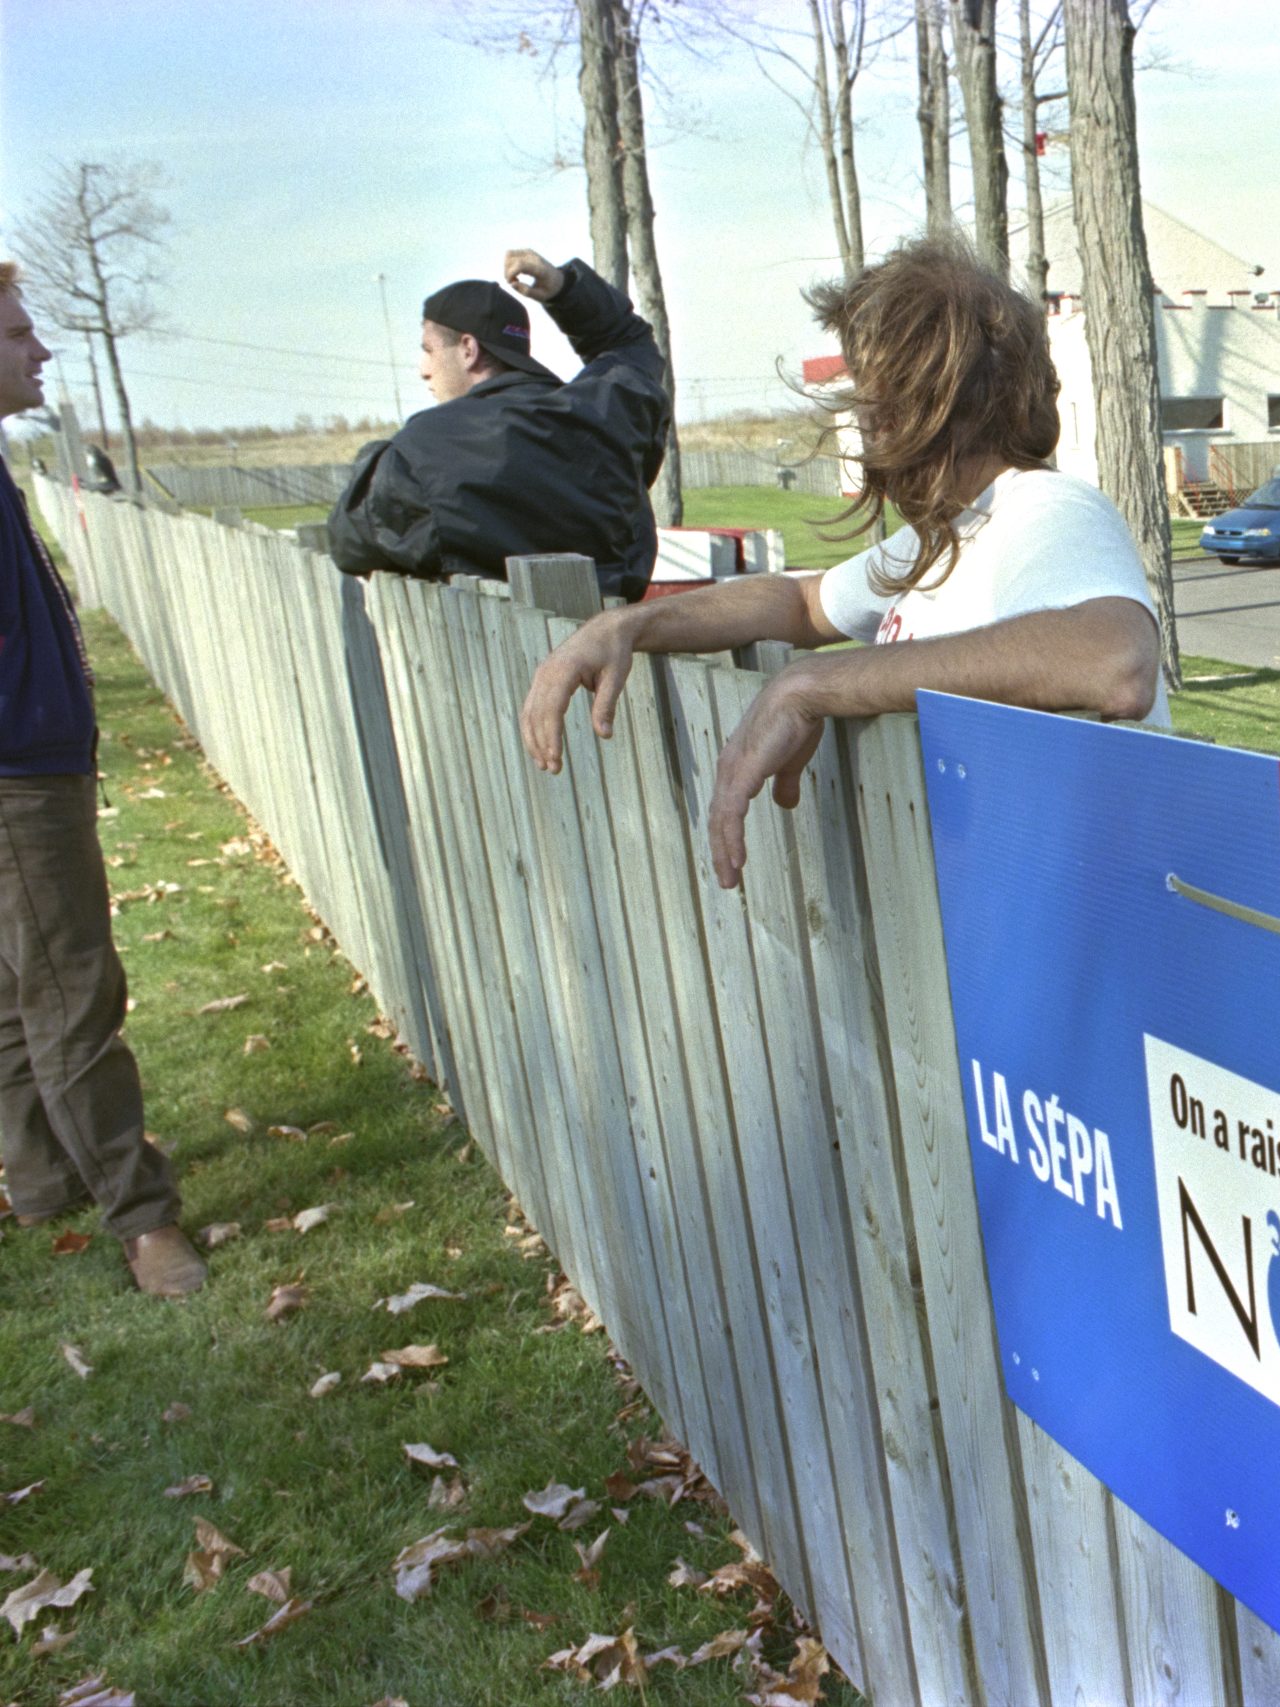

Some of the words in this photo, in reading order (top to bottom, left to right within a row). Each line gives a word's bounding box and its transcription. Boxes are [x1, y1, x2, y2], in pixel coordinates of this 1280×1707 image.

[972, 1058, 1019, 1164] LA
[1022, 1089, 1123, 1230] SÉPA
[1169, 1072, 1206, 1140] On
[1213, 1109, 1230, 1151] a
